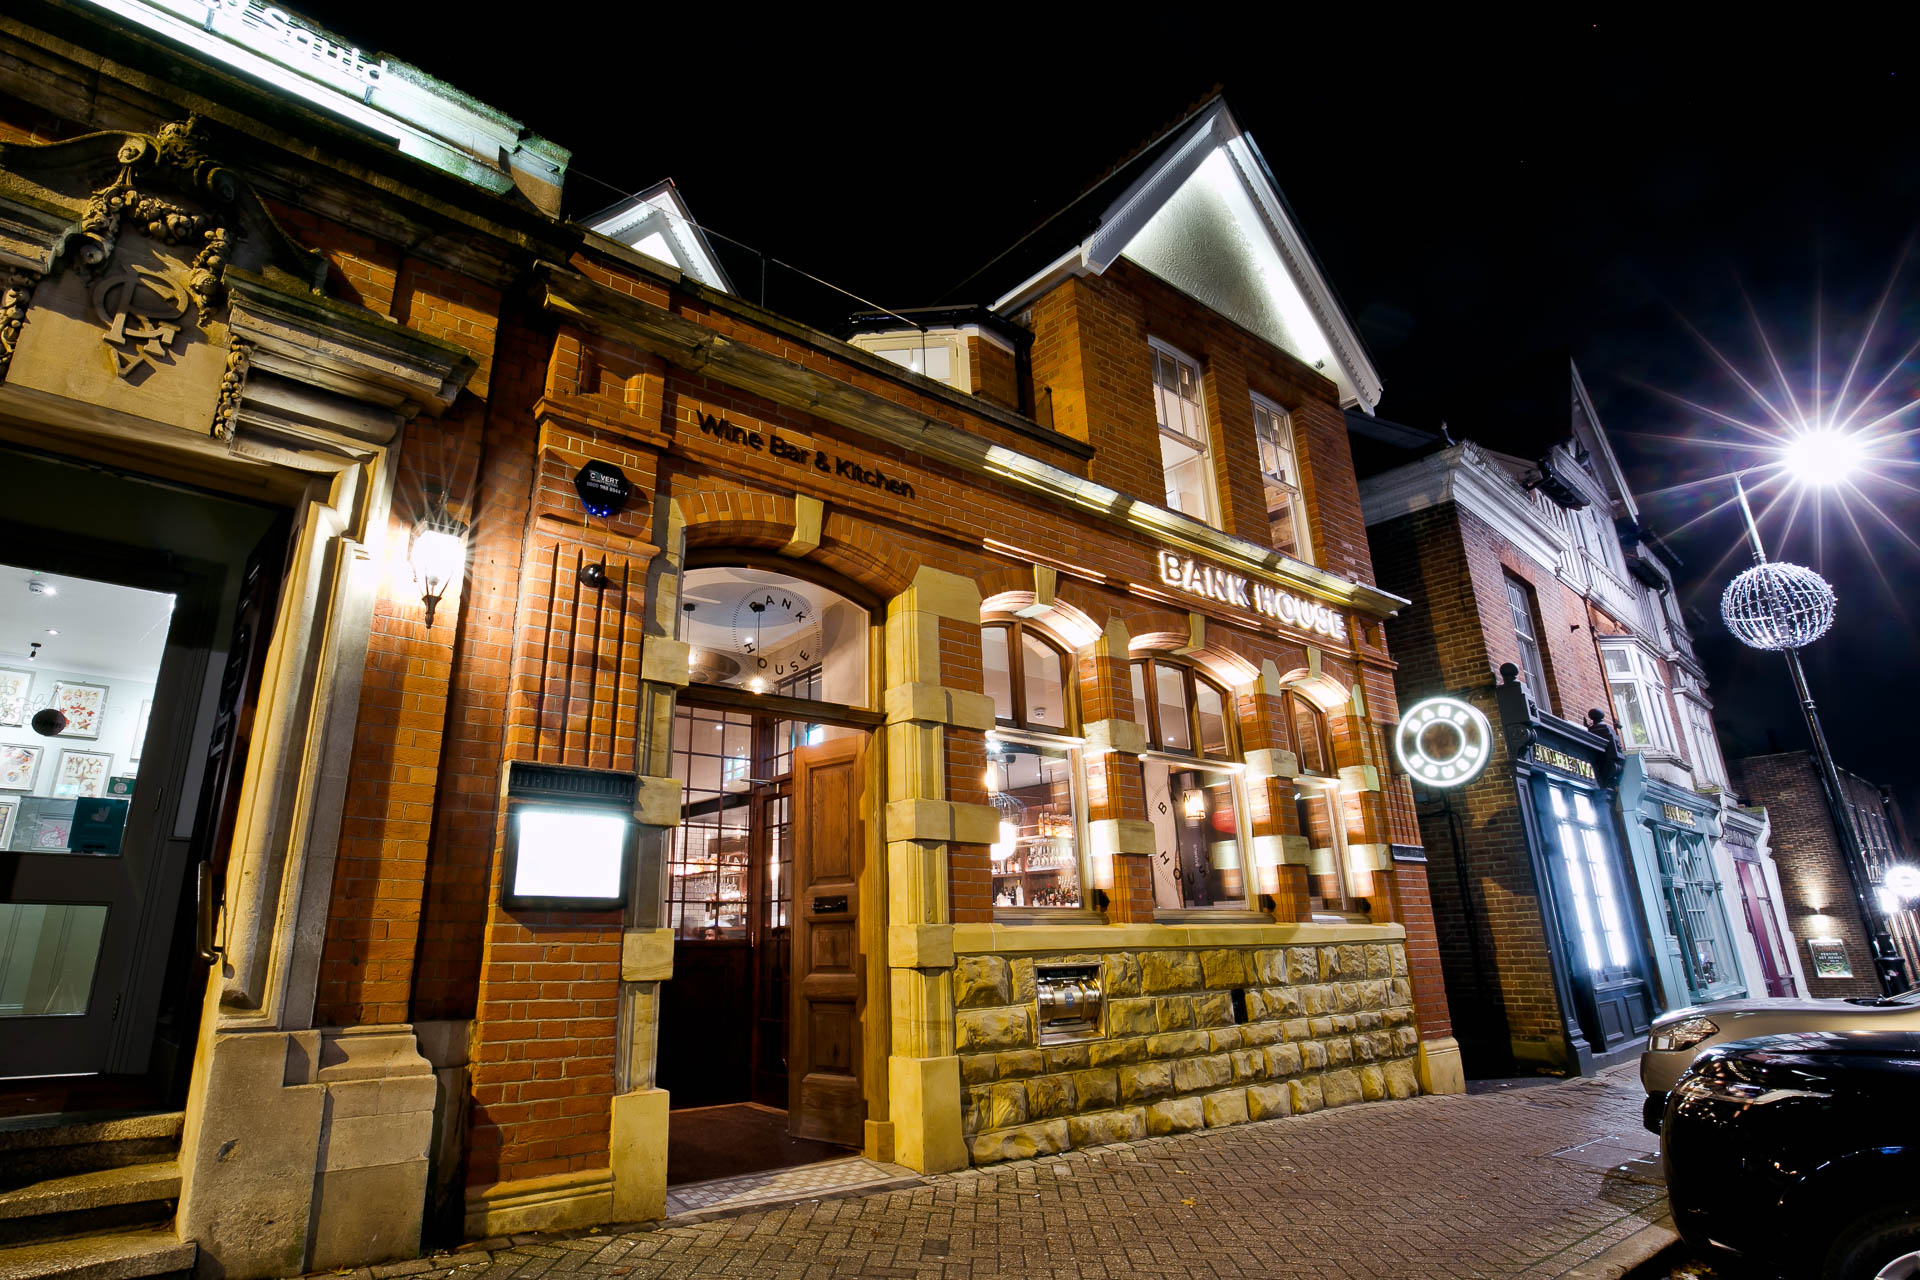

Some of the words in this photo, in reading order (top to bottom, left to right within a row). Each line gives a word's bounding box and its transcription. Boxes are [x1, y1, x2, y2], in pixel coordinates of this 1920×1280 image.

[263, 7, 388, 86] Squid
[696, 410, 764, 451] Wine
[769, 434, 810, 465] Bar
[814, 450, 831, 473] &
[835, 456, 916, 500] Kitchen
[749, 595, 806, 623] BANK
[1159, 550, 1250, 607] BANK
[1254, 584, 1347, 640] HOUSE
[744, 642, 810, 675] HOUSE
[1407, 705, 1469, 732] BANK
[1409, 745, 1479, 779] HOUSE
